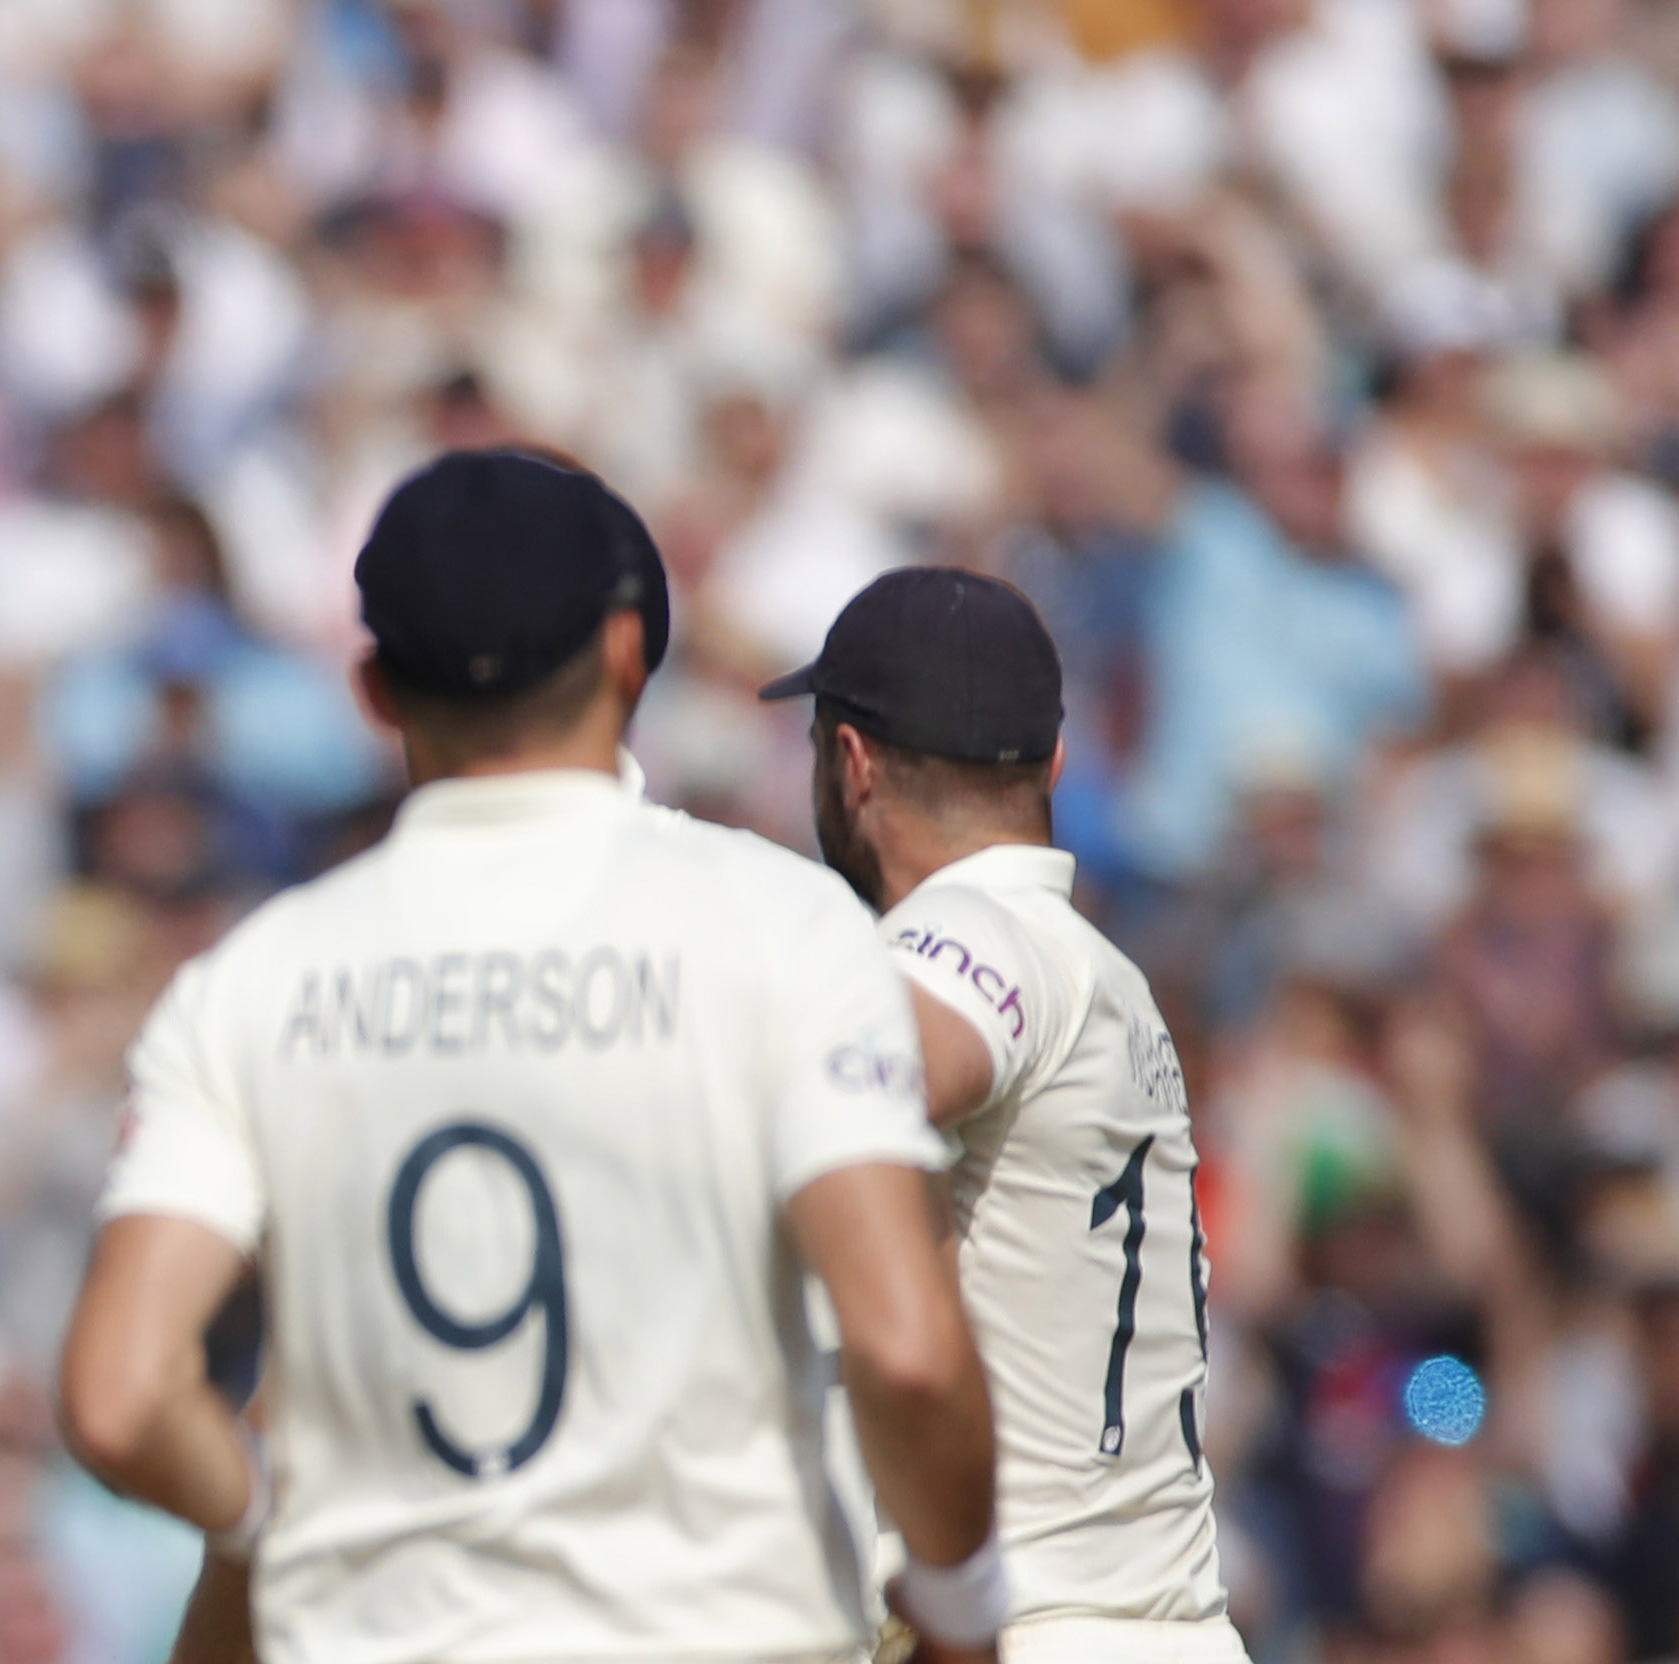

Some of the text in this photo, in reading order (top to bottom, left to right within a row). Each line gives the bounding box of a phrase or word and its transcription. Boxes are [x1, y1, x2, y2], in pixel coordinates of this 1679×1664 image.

[276, 943, 683, 1062] ANDERSON
[386, 1118, 573, 1480] 9
[1090, 1134, 1209, 1482] 1
